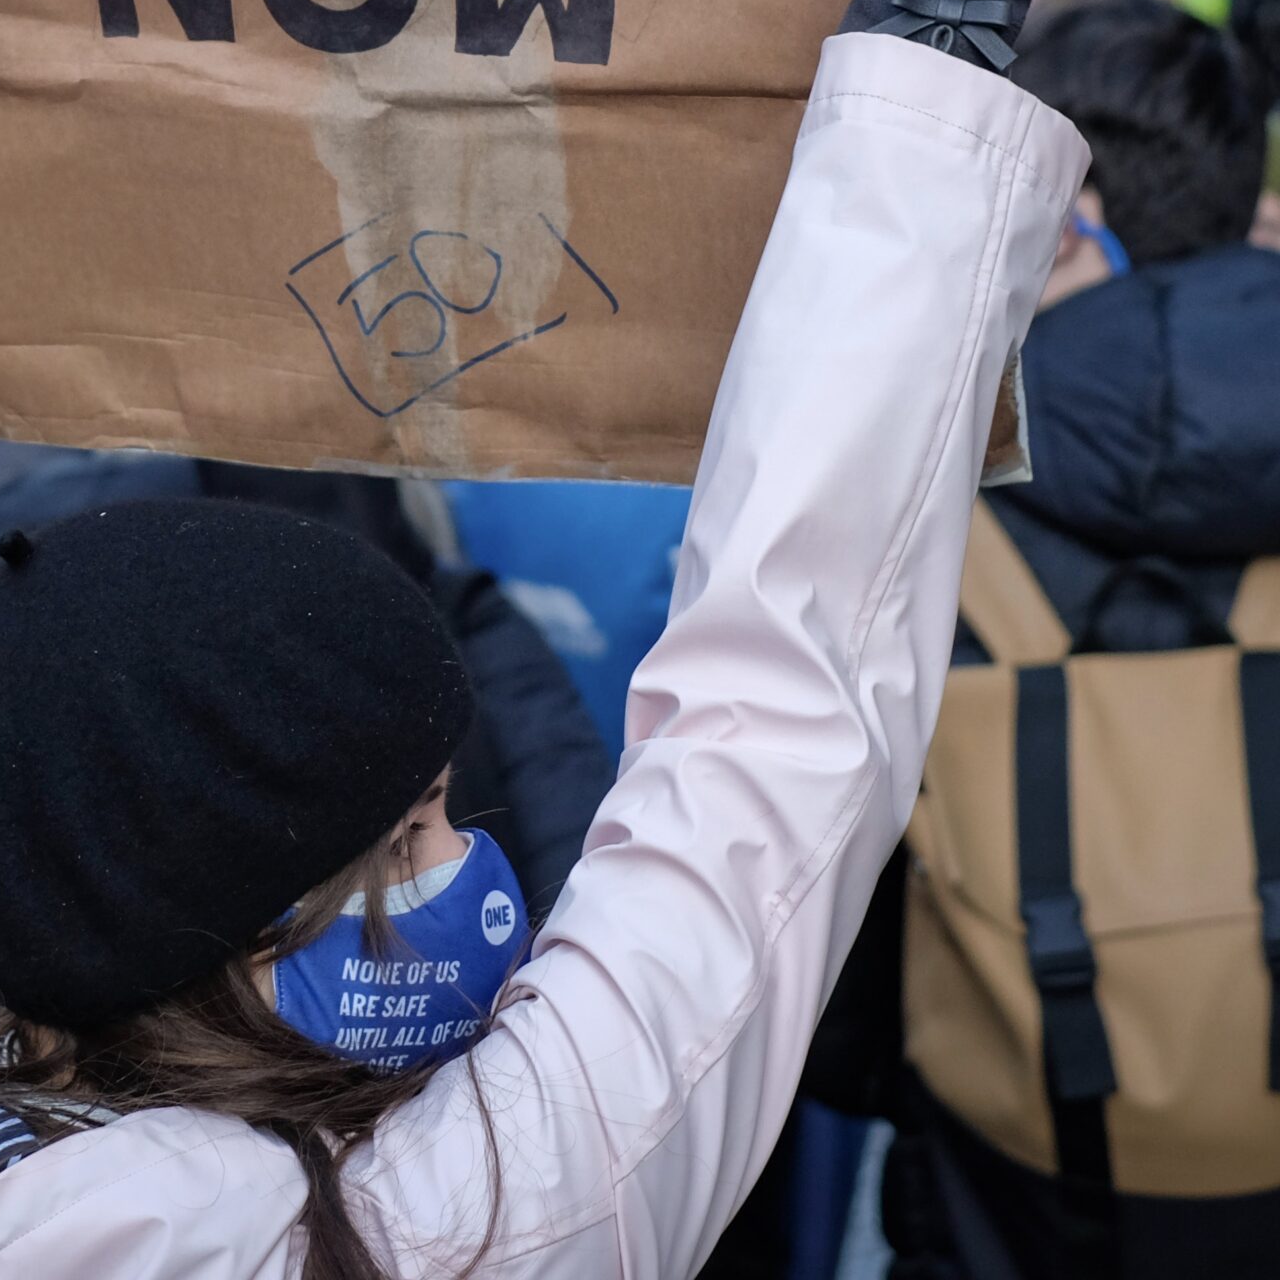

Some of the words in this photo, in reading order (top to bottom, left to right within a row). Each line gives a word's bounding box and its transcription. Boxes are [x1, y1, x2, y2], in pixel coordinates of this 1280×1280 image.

[336, 229, 502, 358] 50
[485, 904, 511, 929] ONE
[342, 957, 404, 985] NONE
[406, 961, 433, 985] OF
[435, 960, 461, 984] US
[339, 991, 381, 1018] ARE
[381, 994, 431, 1018] SAFE
[335, 1027, 388, 1051] UNTIL
[391, 1026, 426, 1048] ALL
[431, 1020, 455, 1045] OF
[453, 1019, 481, 1040] US
